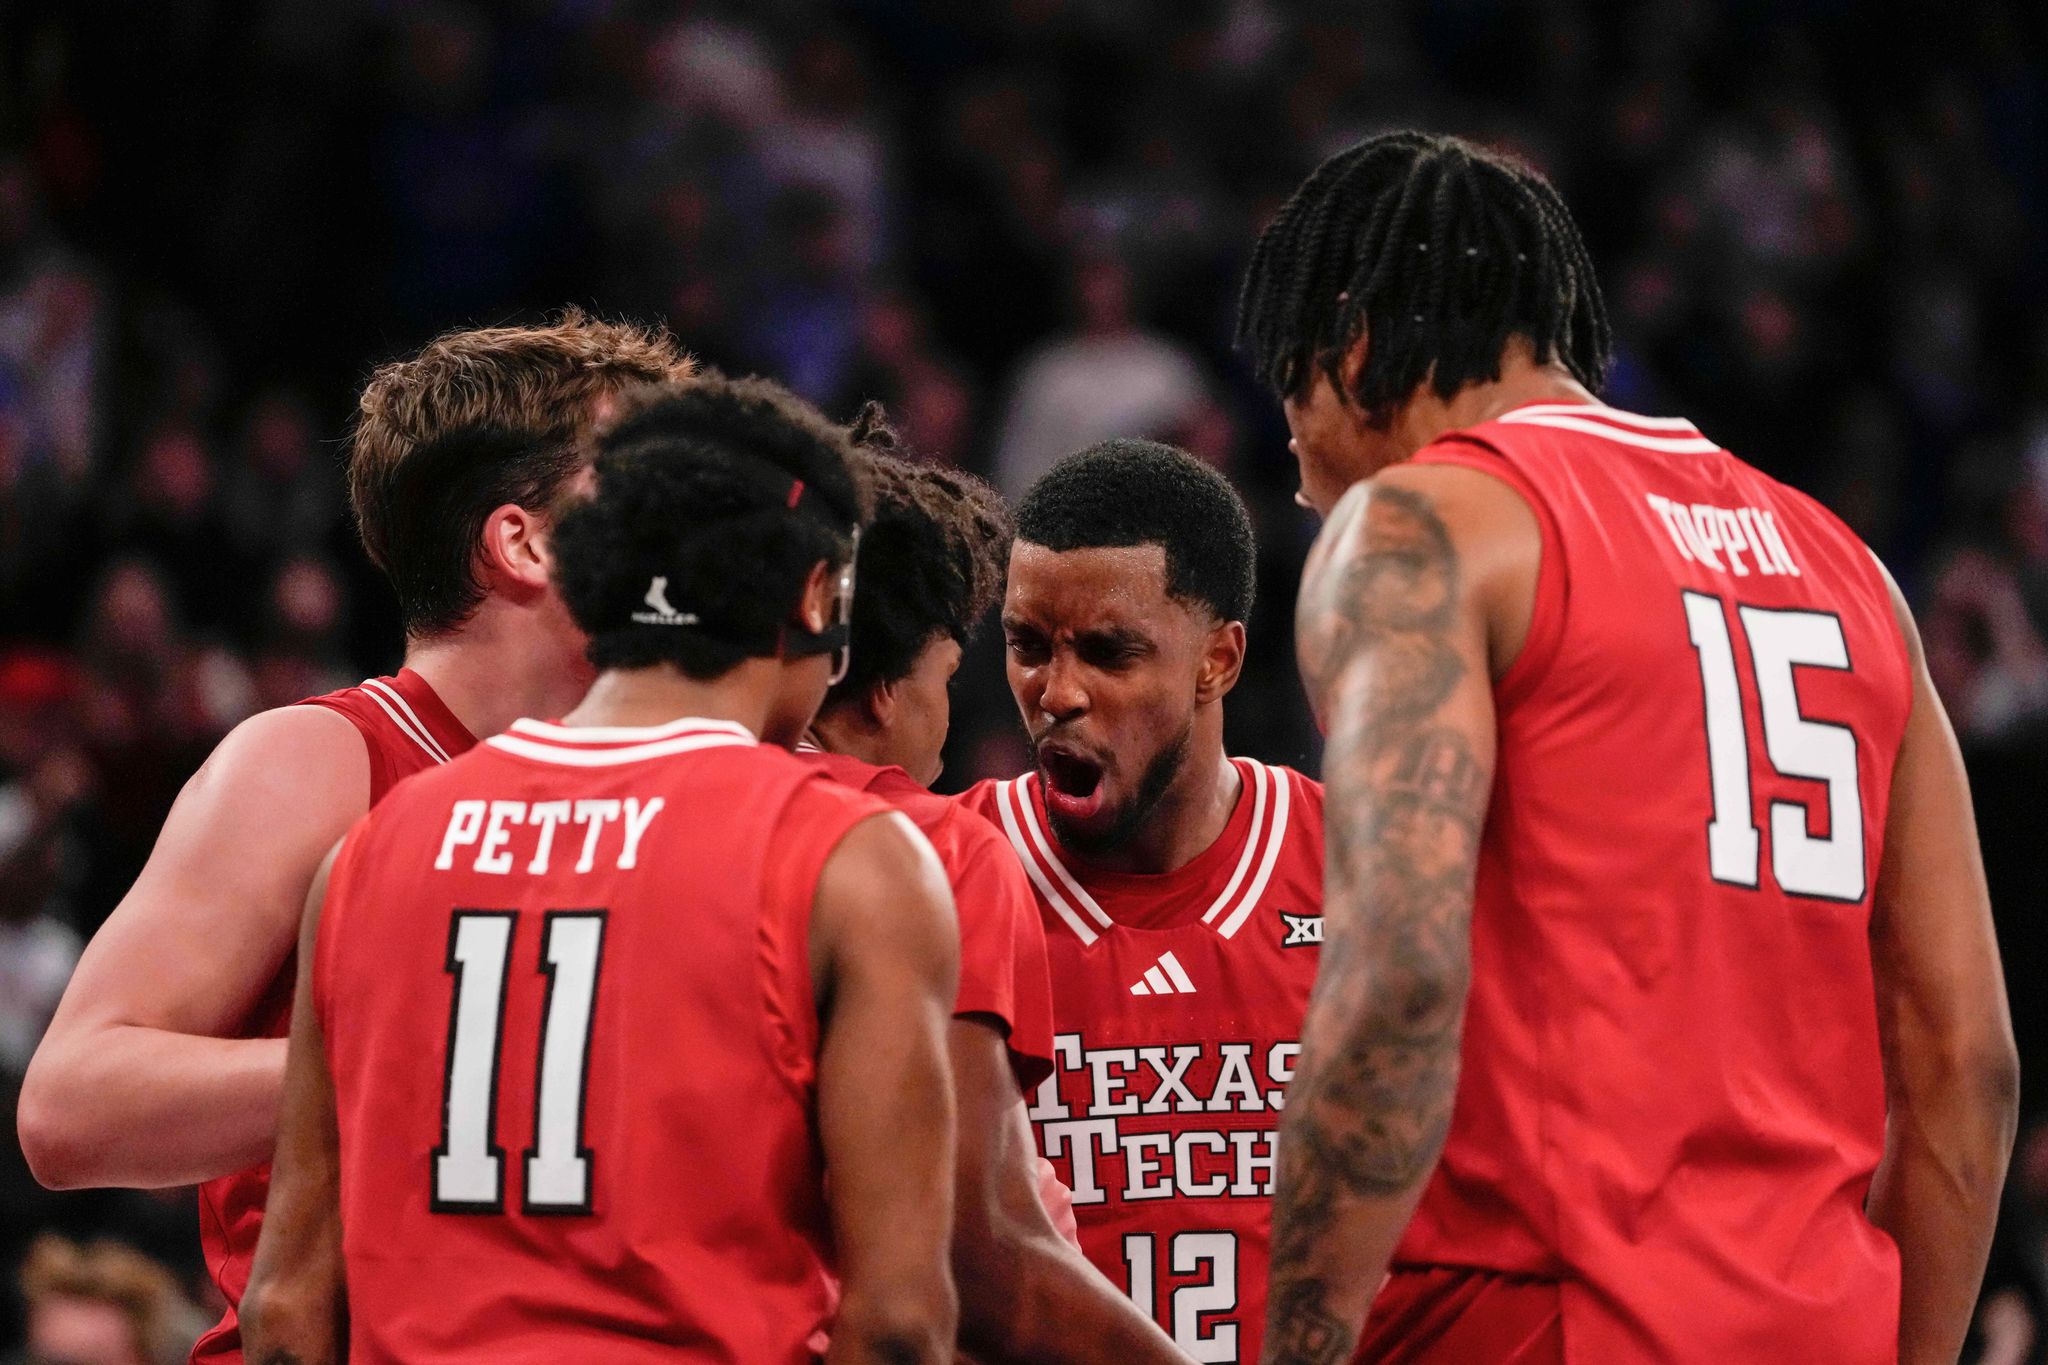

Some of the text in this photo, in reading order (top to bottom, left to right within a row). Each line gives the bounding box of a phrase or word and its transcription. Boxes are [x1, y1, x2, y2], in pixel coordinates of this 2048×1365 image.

[1646, 493, 1801, 577] TOPPIN
[1681, 588, 1866, 904] 15
[435, 797, 664, 875] PETTY
[430, 909, 608, 1216] 11
[1029, 1032, 1302, 1121] TEXAS
[1043, 1117, 1280, 1205] TECH
[1122, 1231, 1240, 1365] 12
